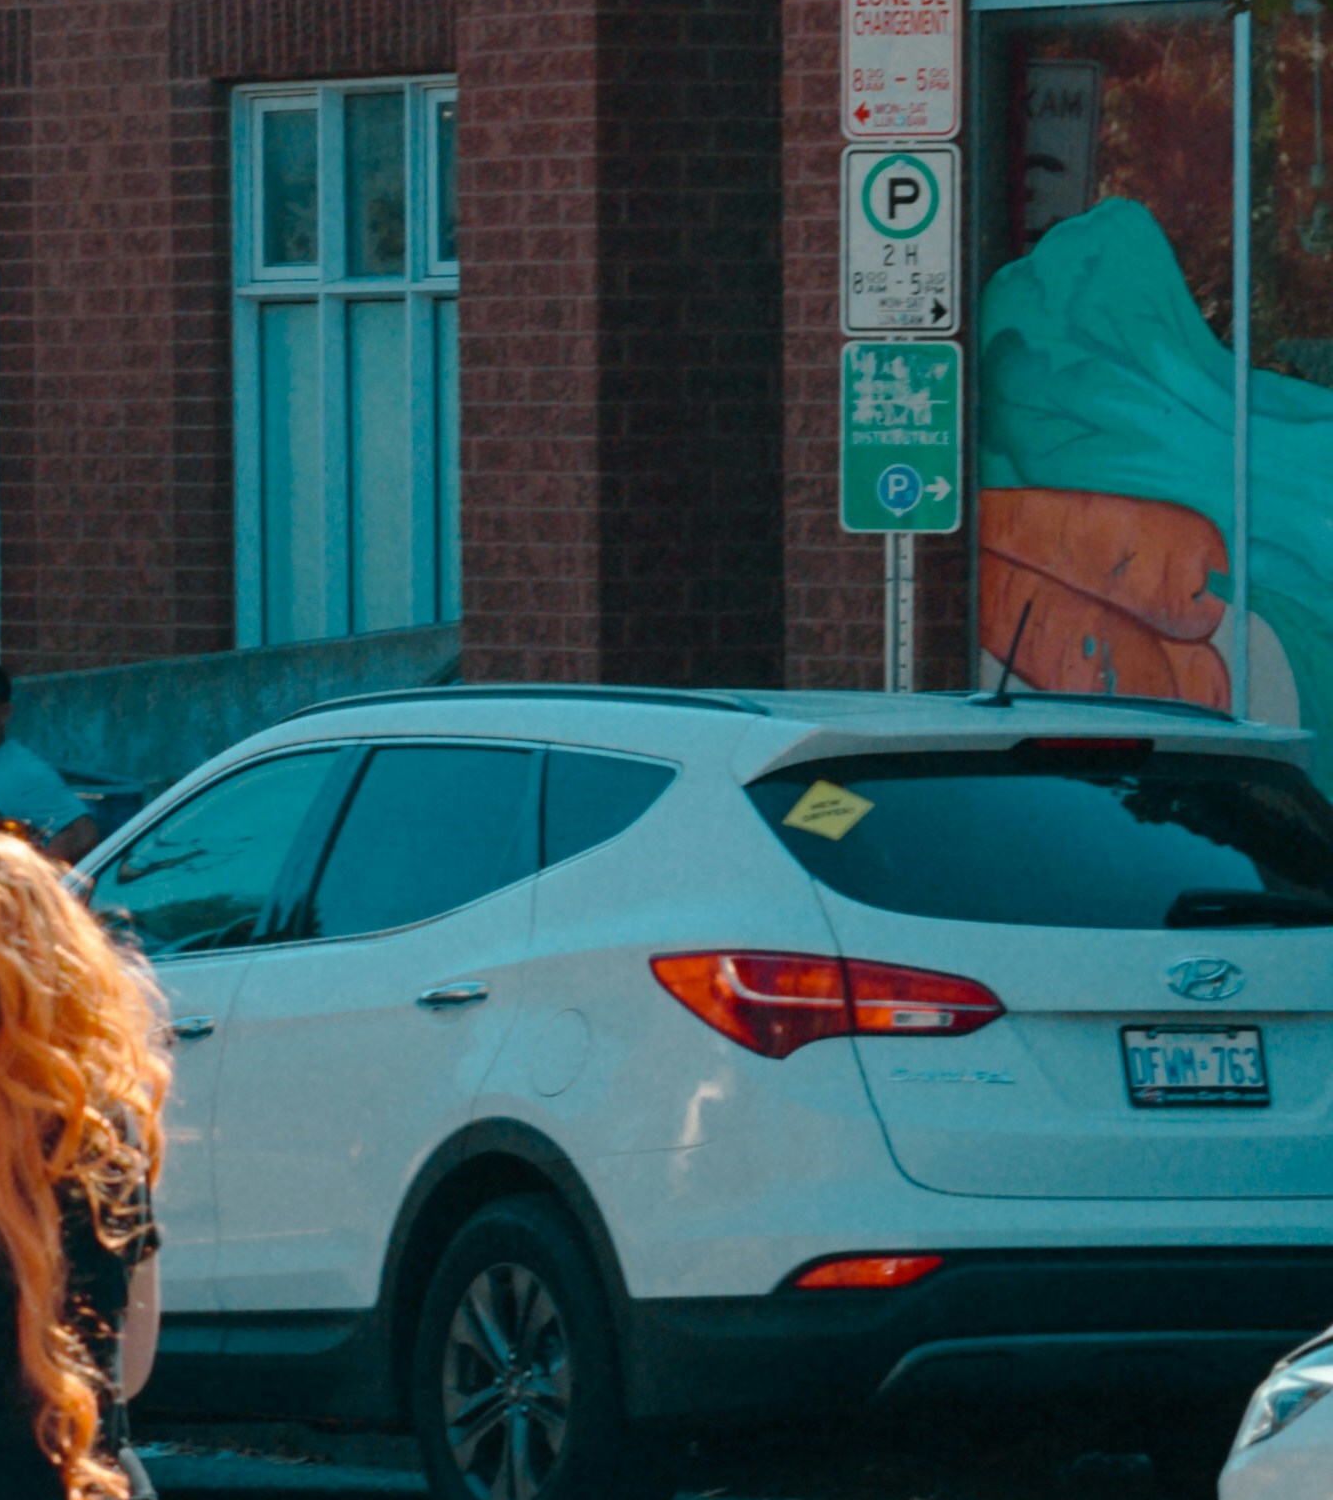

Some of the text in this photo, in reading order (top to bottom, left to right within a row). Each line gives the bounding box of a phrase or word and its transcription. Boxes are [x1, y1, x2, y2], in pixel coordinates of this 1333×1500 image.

[853, 9, 950, 36] CHARGEMENT
[852, 68, 864, 92] 8
[916, 68, 926, 92] 5
[888, 177, 920, 220] P
[882, 243, 919, 266] 2 H
[853, 271, 864, 294] 8
[910, 272, 921, 295] 5
[888, 474, 909, 500] P
[1211, 1046, 1263, 1085] 763
